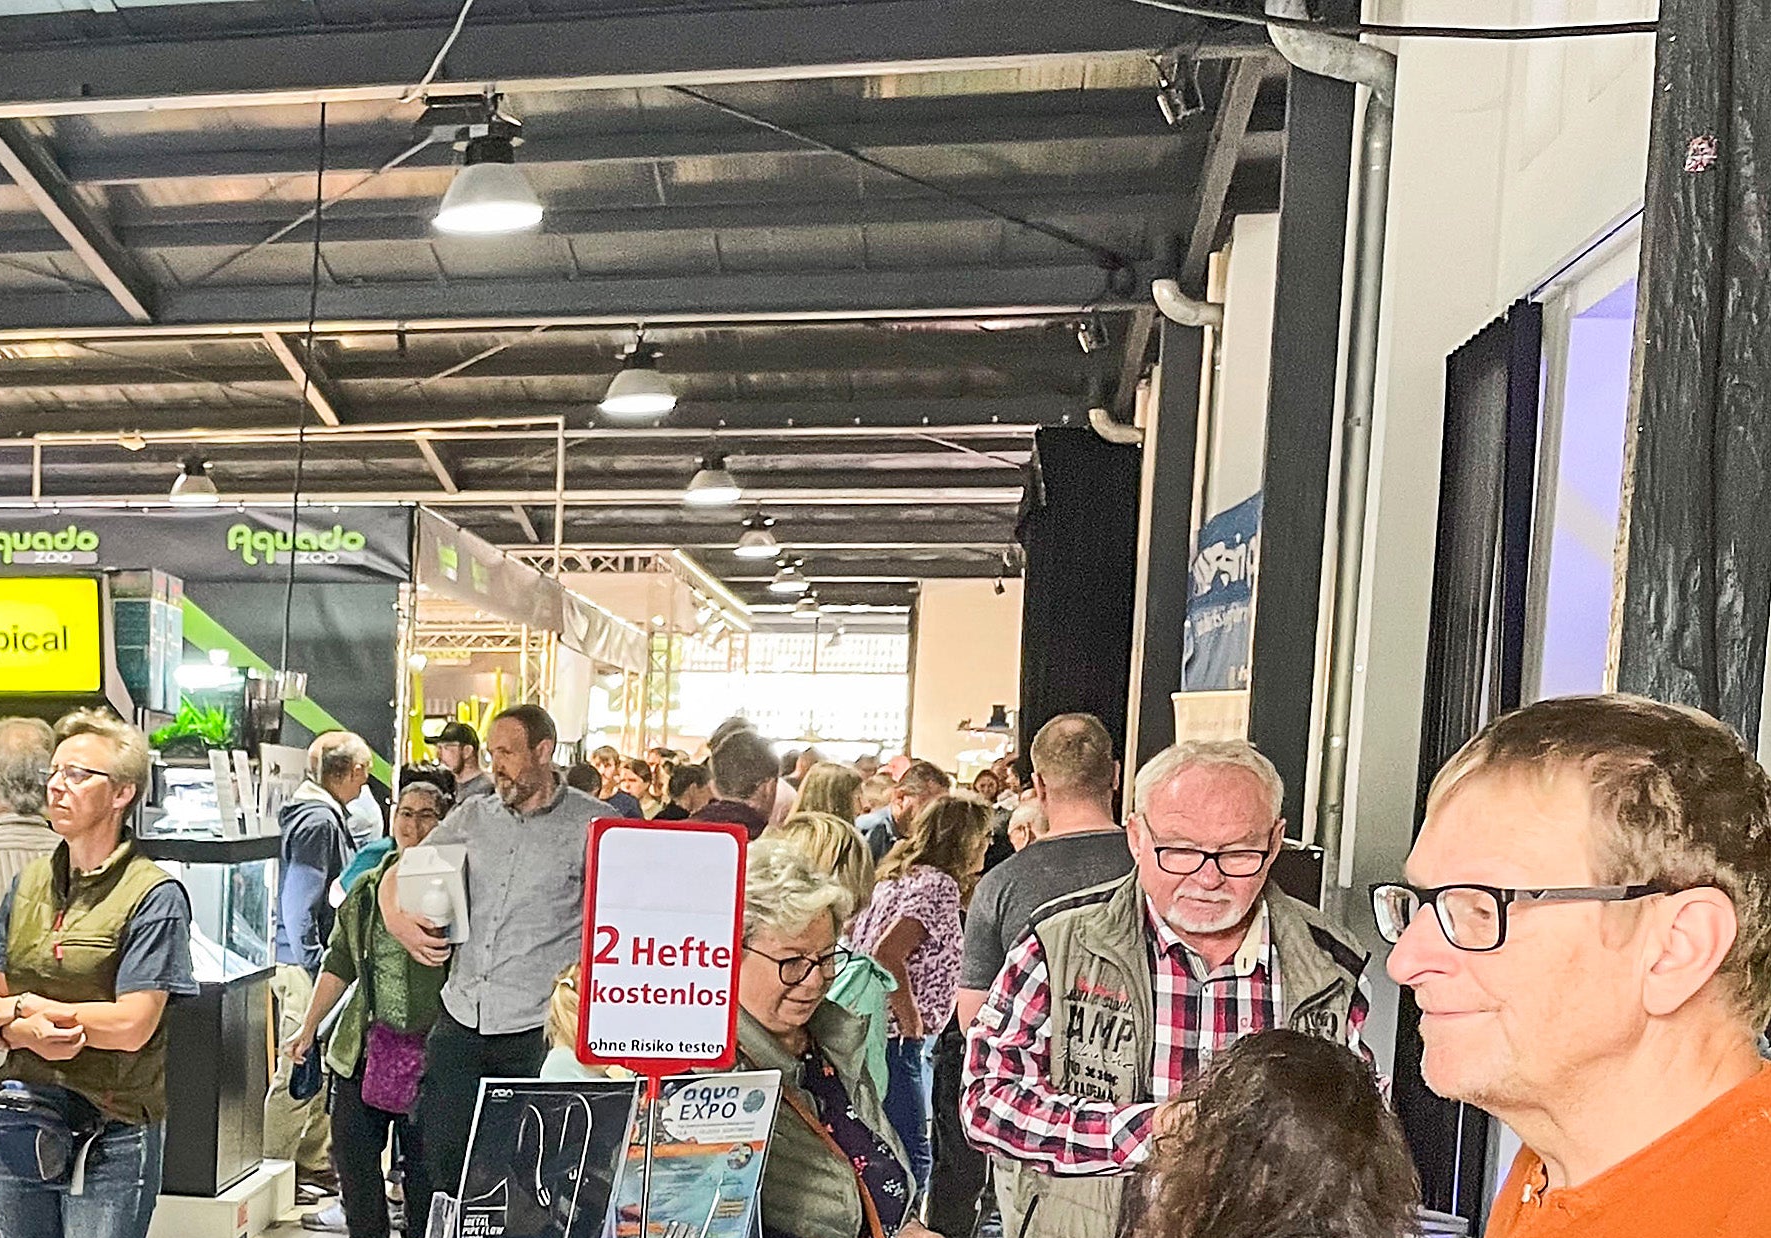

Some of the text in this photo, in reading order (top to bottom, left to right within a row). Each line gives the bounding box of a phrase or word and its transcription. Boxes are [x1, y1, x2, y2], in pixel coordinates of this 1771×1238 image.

[227, 523, 367, 565] Aquado
[594, 925, 731, 969] 2 Hefte
[592, 979, 728, 1007] kostenlos
[589, 1038, 725, 1054] ohne Risiko testen
[683, 1085, 741, 1106] aqua
[679, 1101, 738, 1121] EXPO
